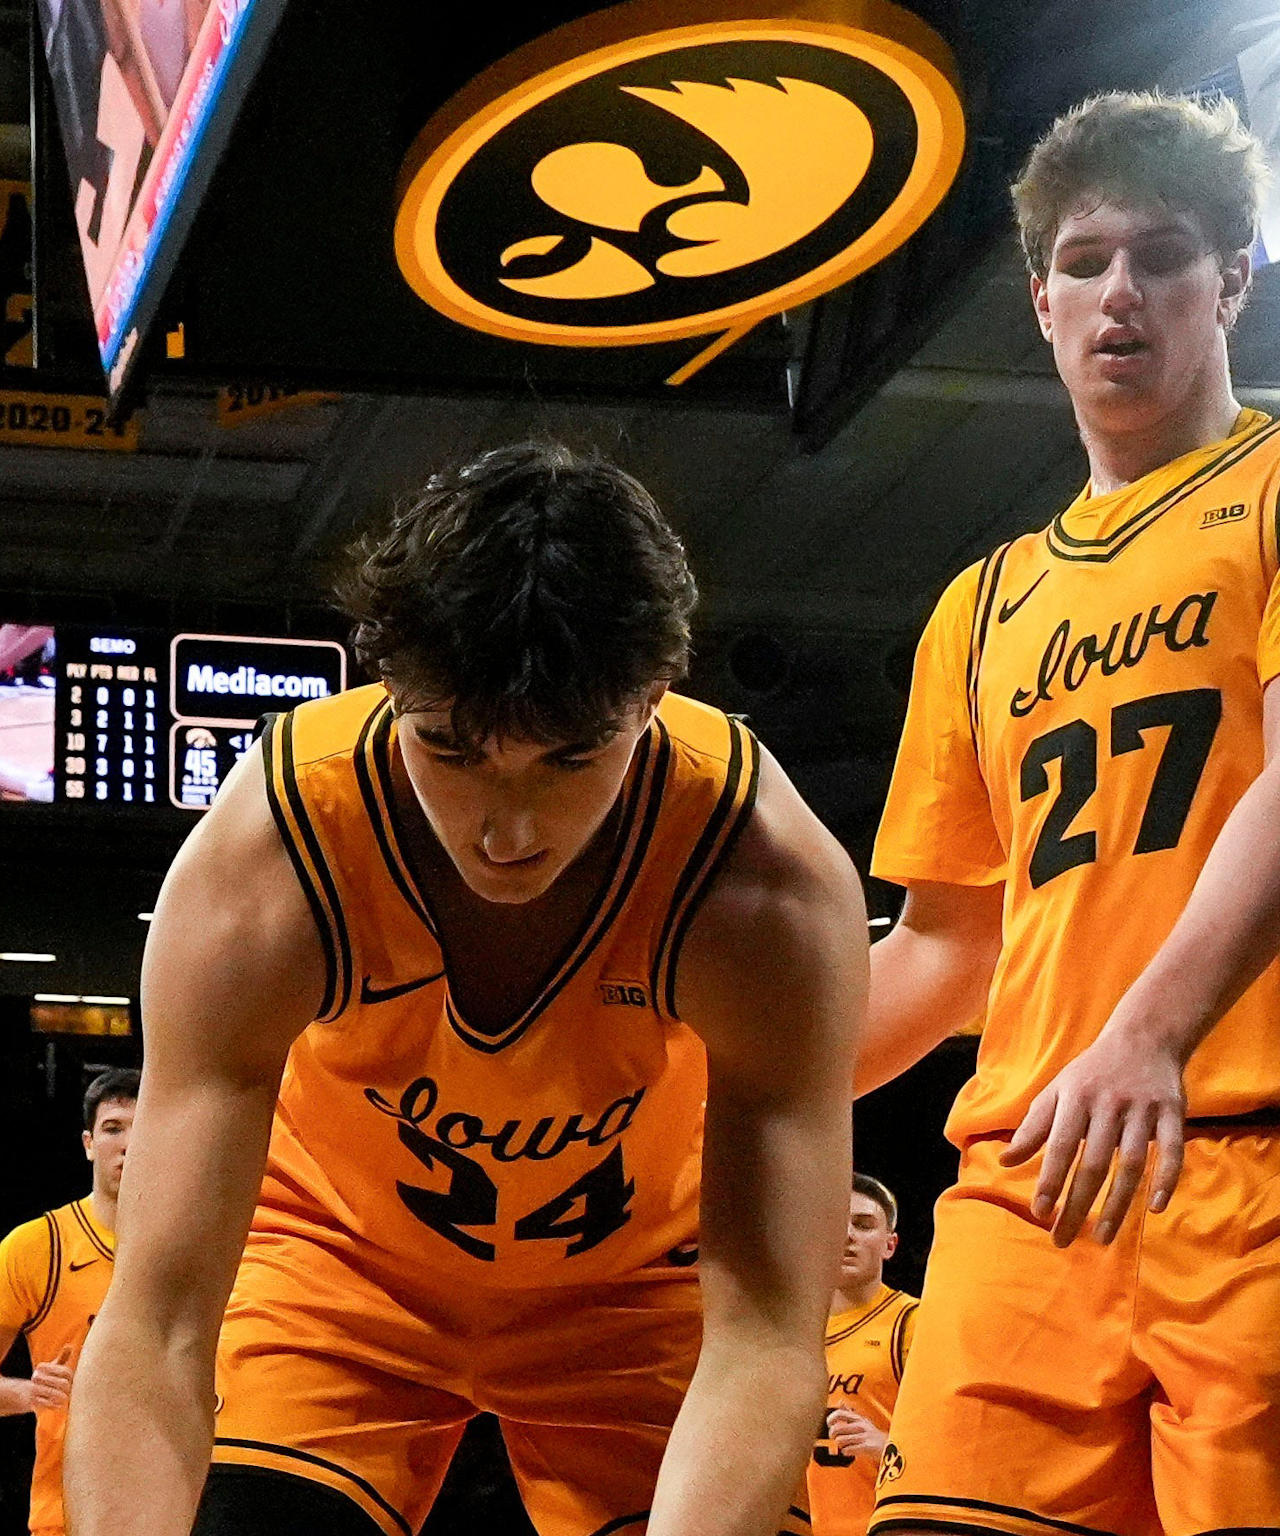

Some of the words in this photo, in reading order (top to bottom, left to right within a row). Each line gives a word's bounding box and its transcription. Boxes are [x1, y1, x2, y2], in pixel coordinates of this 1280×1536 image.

[1009, 591, 1218, 717] Iowa
[187, 664, 328, 699] Mediacom
[145, 690, 155, 709] 1
[123, 711, 134, 730] 1
[145, 712, 155, 731] 1
[96, 733, 108, 753] 7
[123, 735, 134, 754] 1
[145, 736, 155, 755] 1
[145, 760, 155, 779] 1
[184, 749, 217, 778] 45
[123, 782, 133, 802] 1
[145, 783, 155, 803] 1
[1020, 688, 1222, 889] 27
[363, 1077, 647, 1163] Iowa
[395, 1123, 636, 1262] 24
